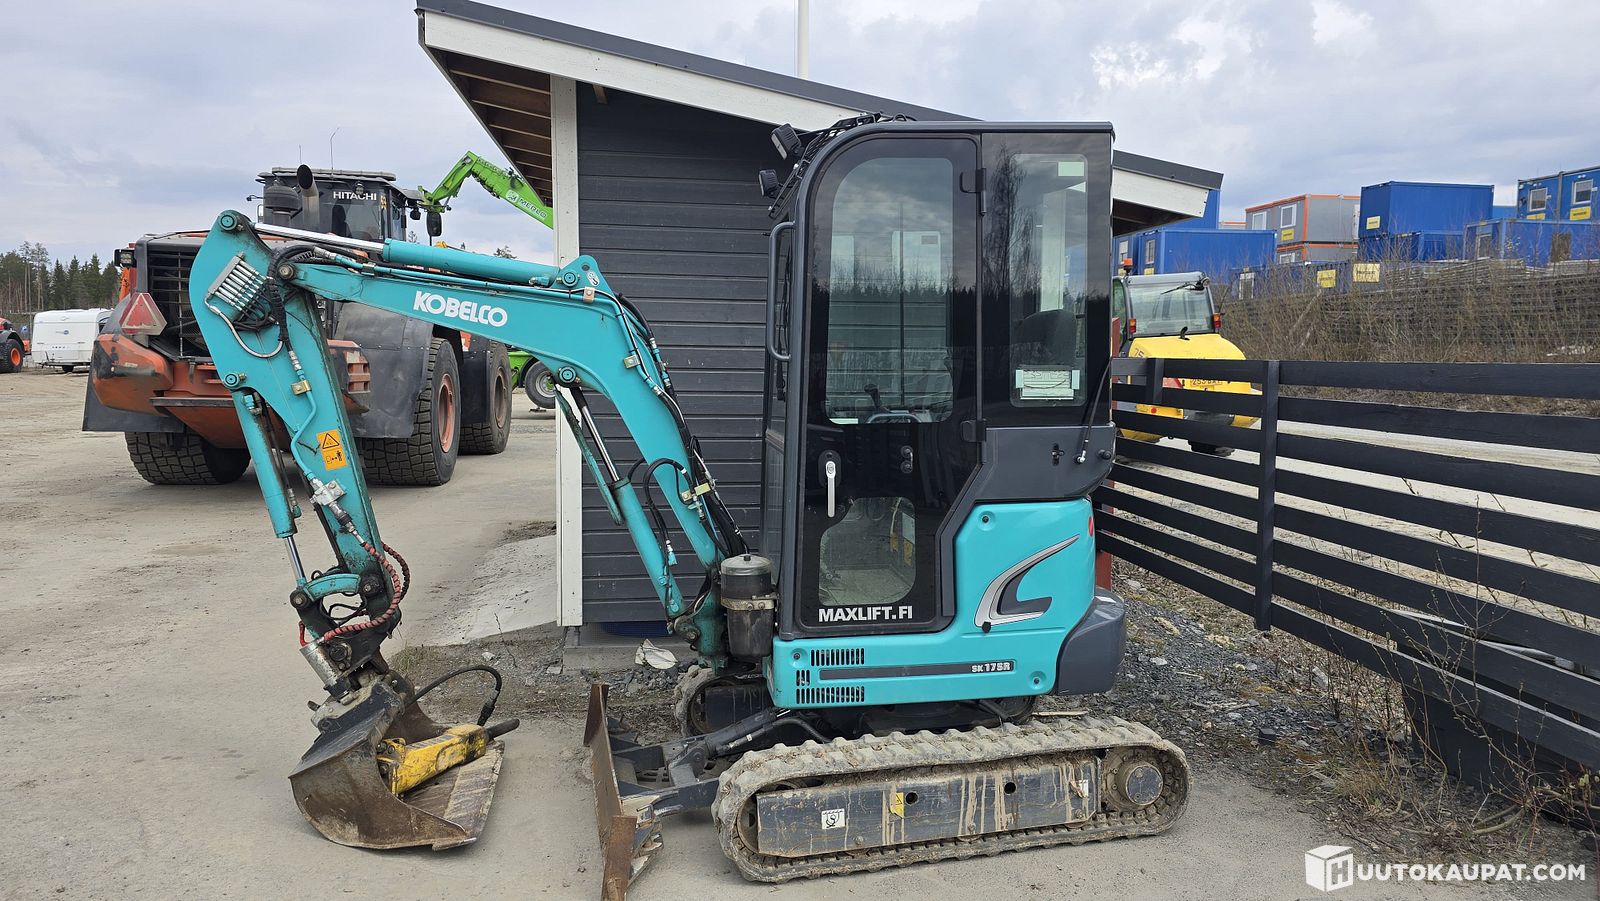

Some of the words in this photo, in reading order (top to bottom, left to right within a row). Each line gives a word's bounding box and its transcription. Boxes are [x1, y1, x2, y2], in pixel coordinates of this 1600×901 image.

[333, 191, 377, 201] HITACHI
[518, 198, 548, 219] MERLO
[413, 290, 508, 327] KOBELCO
[818, 605, 913, 622] MAXLIFT.FI
